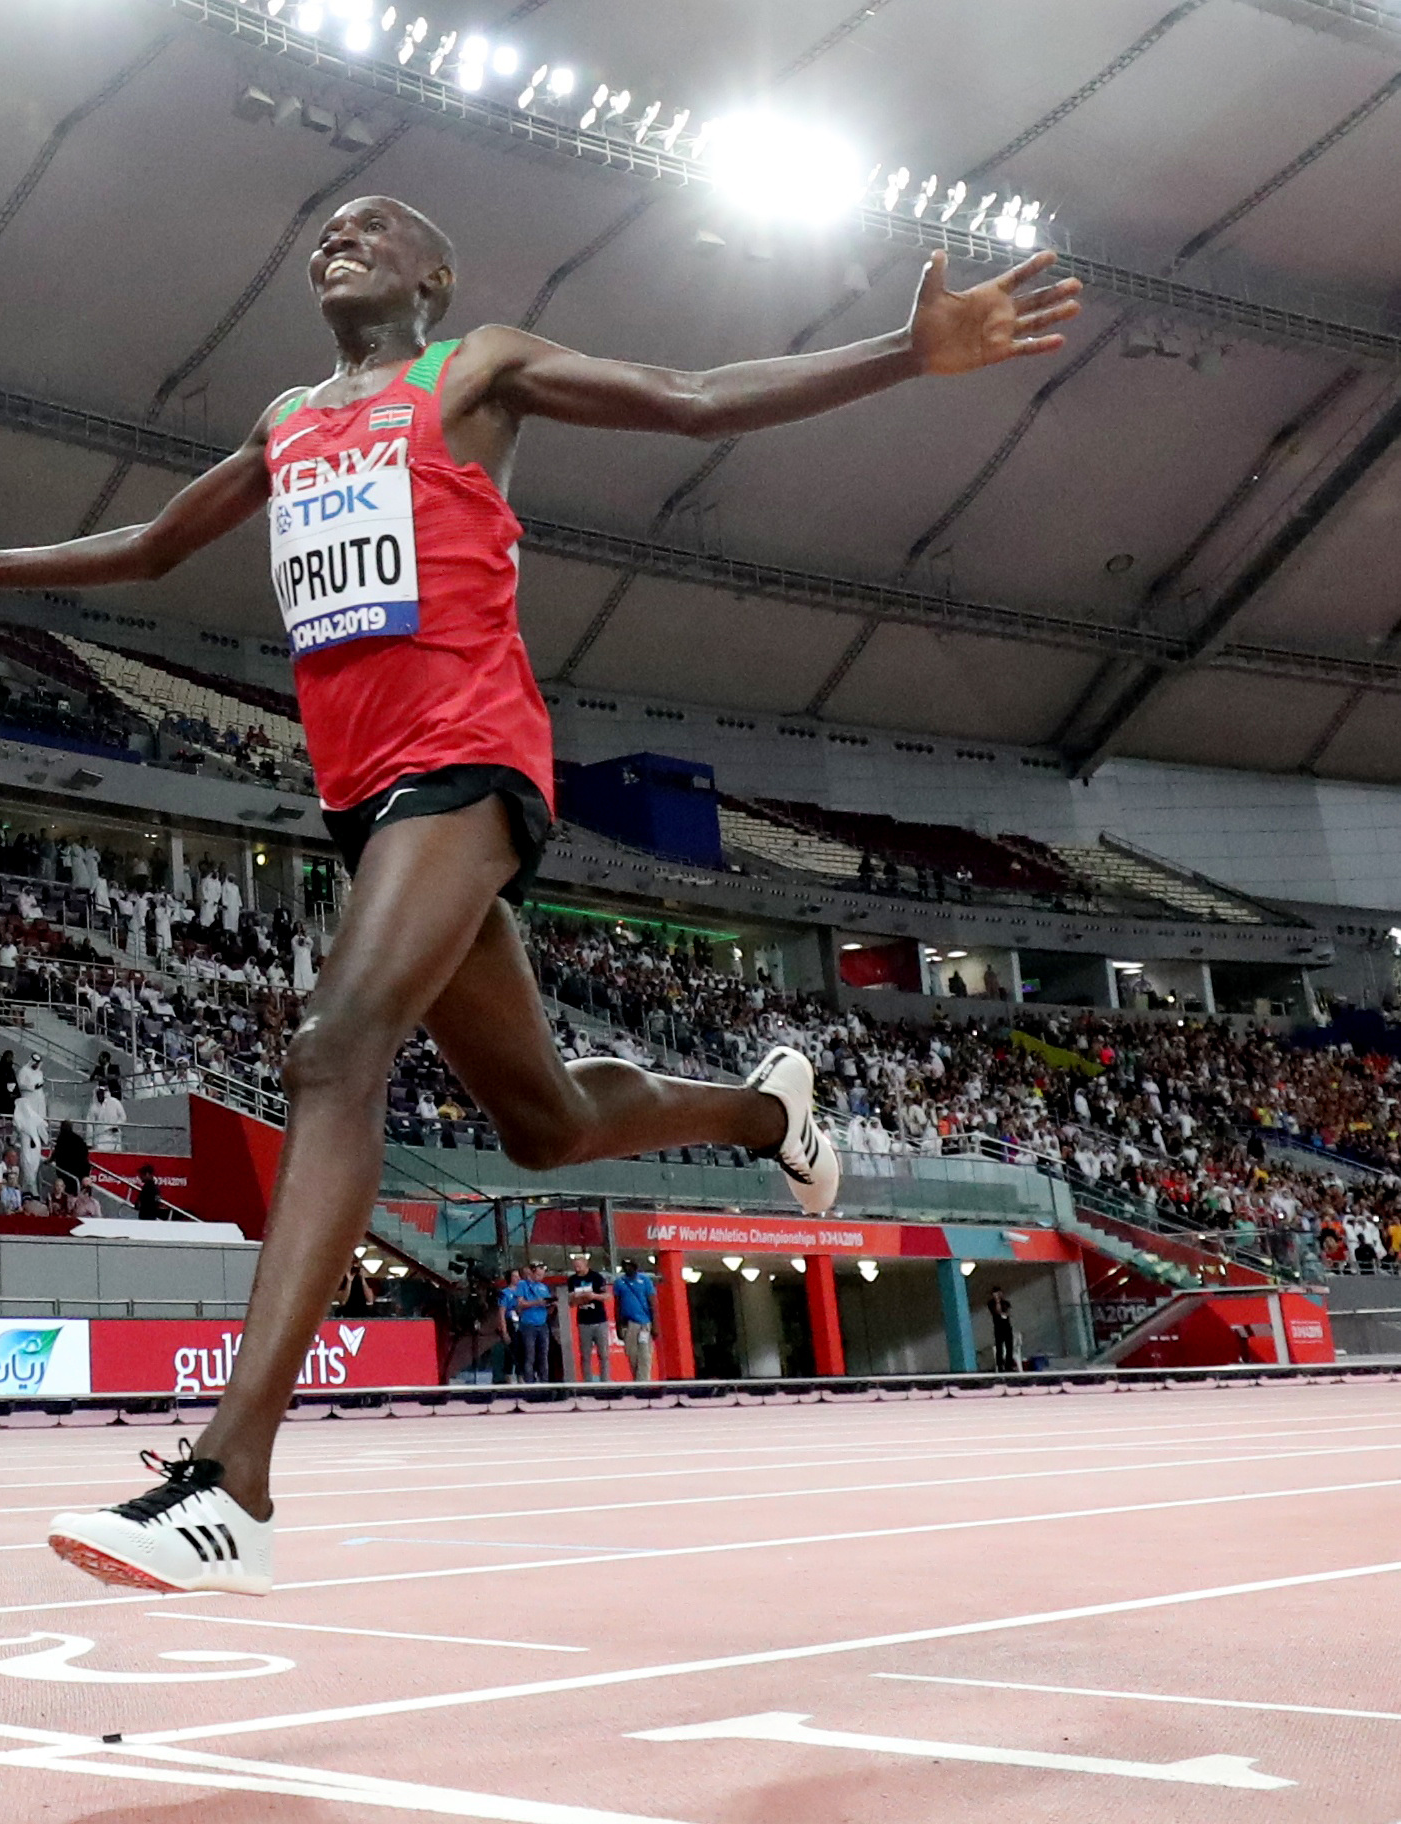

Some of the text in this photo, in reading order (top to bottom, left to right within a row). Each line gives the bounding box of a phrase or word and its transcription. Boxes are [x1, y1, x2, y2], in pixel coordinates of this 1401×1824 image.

[272, 438, 409, 498] KENYA
[293, 481, 379, 526] TDK
[275, 533, 402, 614] KIPRUTO
[647, 1225, 677, 1240] IAAF
[679, 1226, 707, 1241] World
[708, 1228, 748, 1243] Athletics
[750, 1229, 816, 1247] Championships
[623, 1711, 1295, 1790] 1
